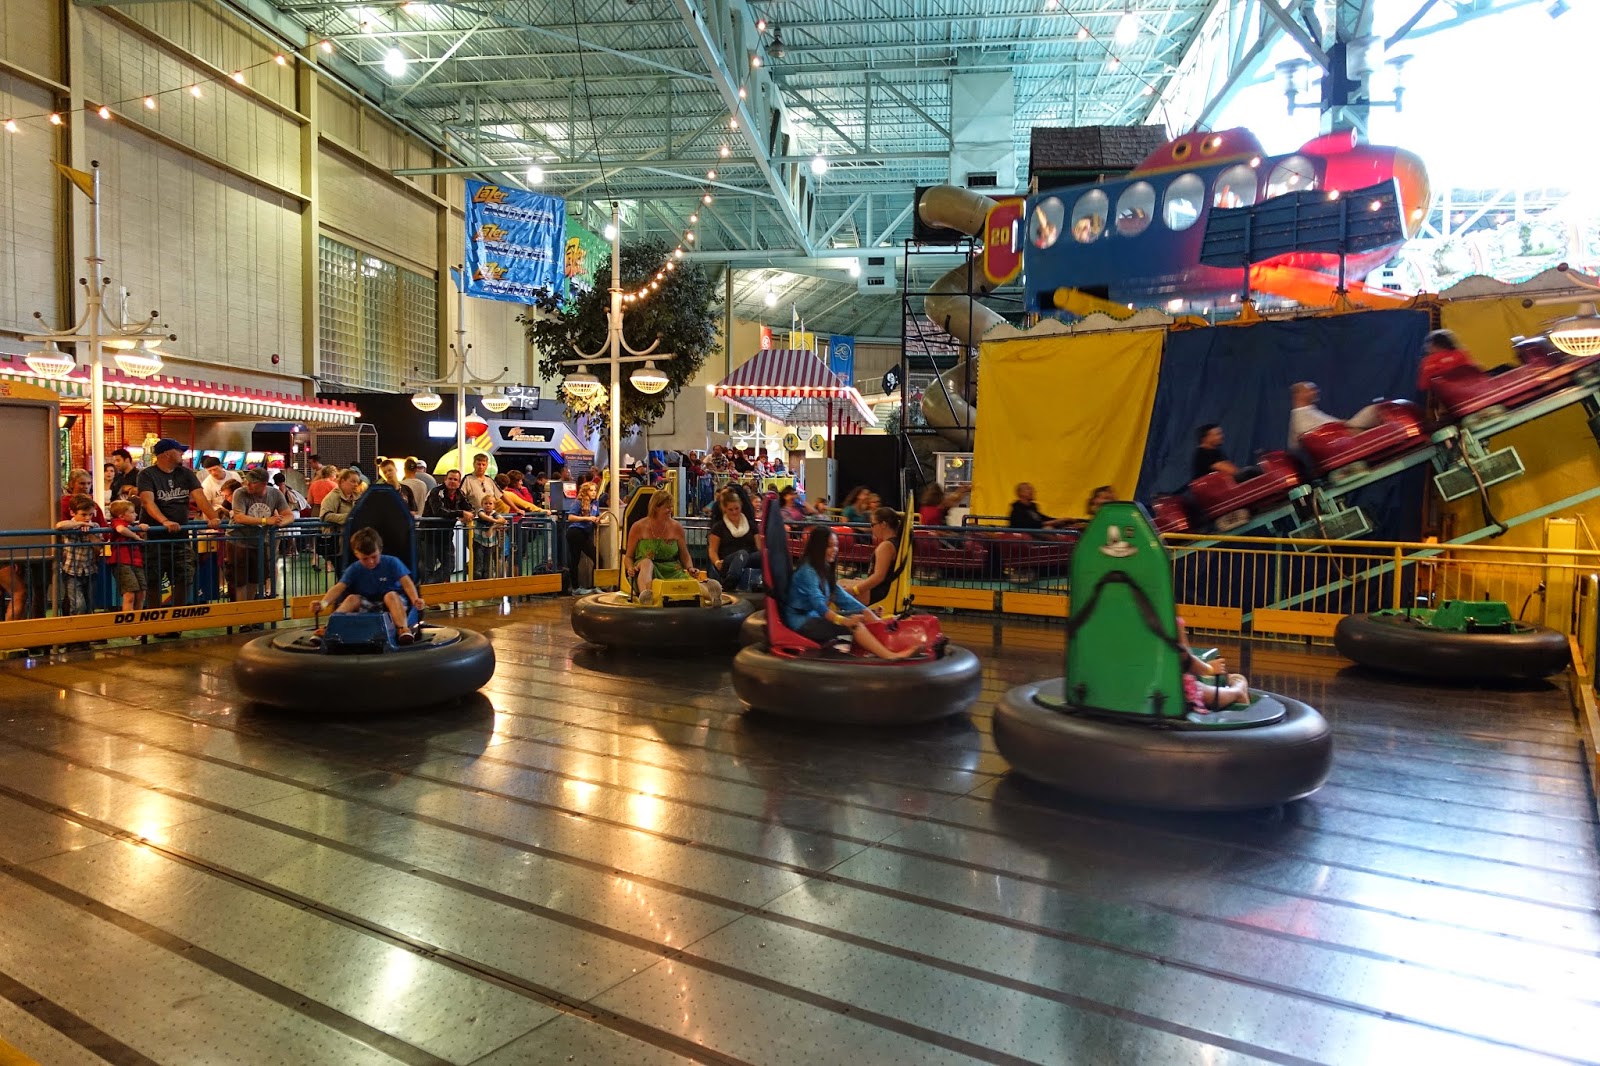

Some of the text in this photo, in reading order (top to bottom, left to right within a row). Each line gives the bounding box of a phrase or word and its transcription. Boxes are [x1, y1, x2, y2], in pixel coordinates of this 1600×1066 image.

[990, 226, 1010, 246] 20
[114, 606, 210, 624] DO NOT BUMP
